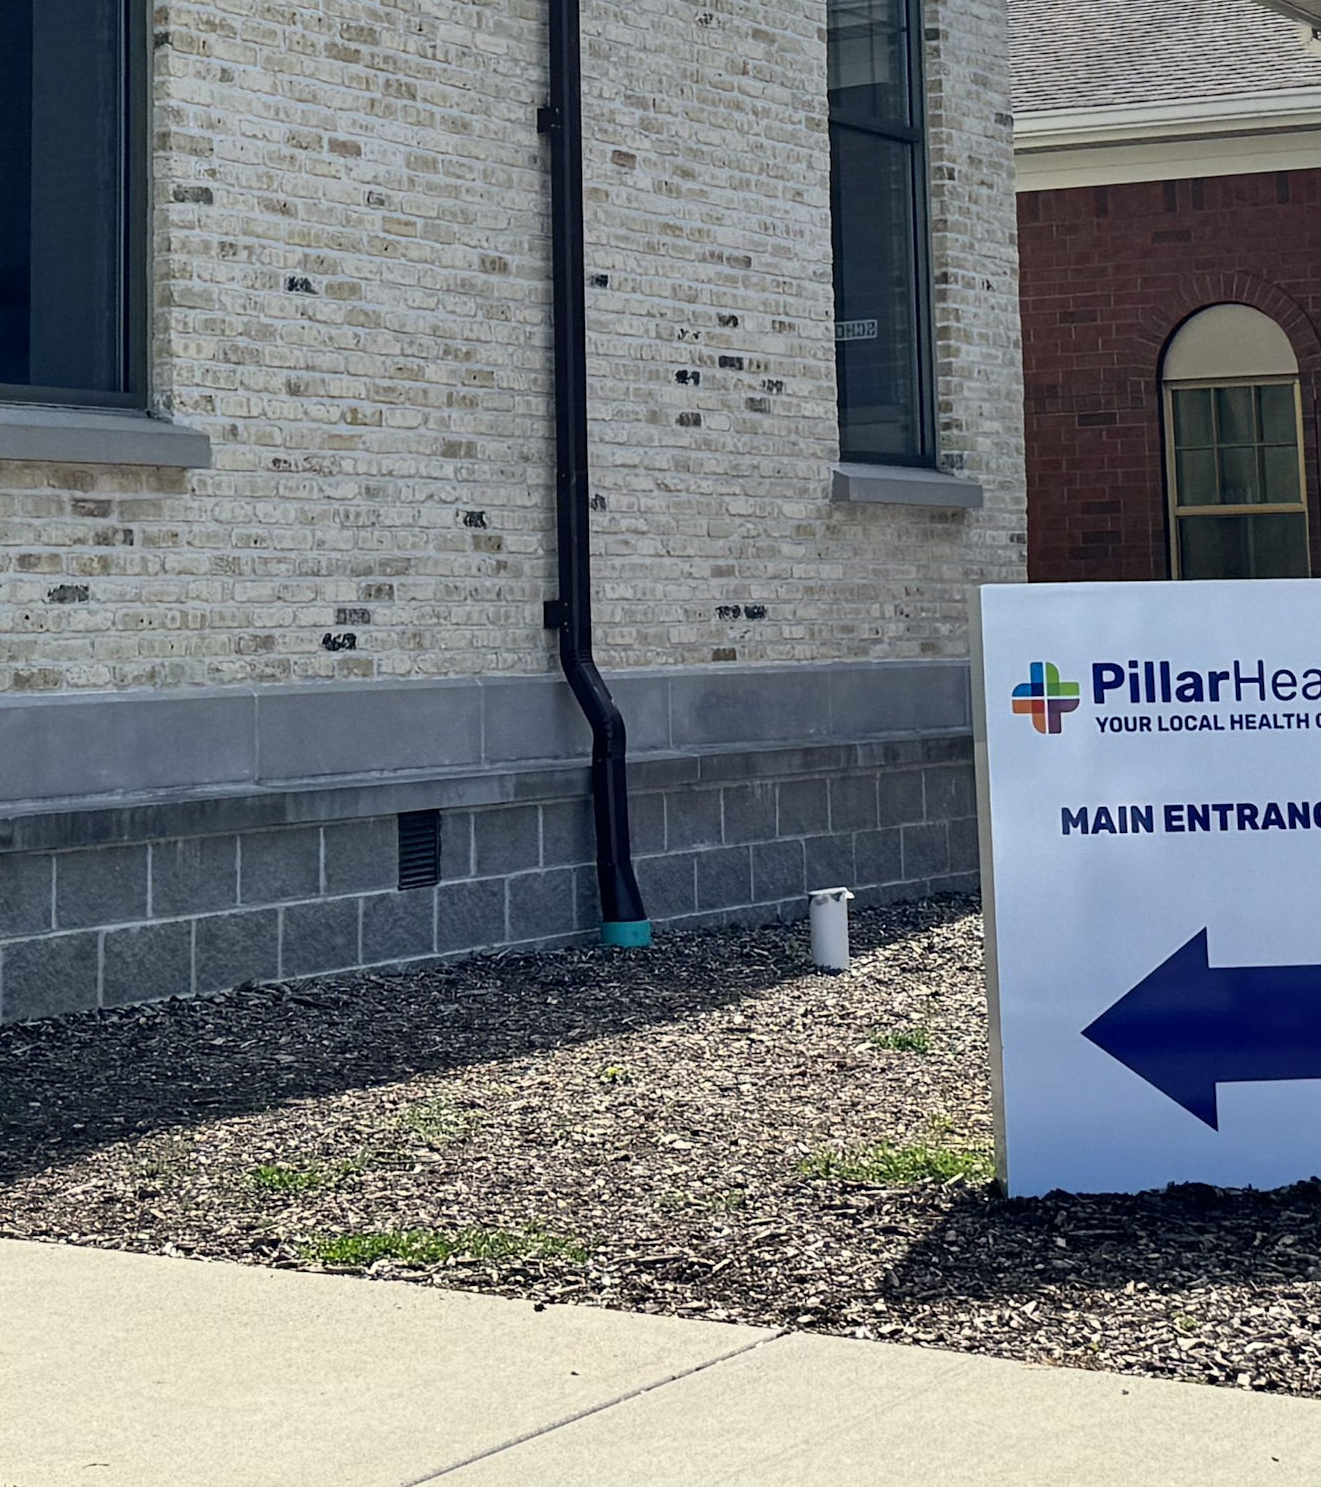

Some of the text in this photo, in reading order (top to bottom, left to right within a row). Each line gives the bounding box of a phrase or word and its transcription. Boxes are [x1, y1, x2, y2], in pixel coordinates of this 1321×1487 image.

[1095, 715, 1152, 733] YOUR
[1157, 714, 1225, 732] LOCAL
[1230, 713, 1310, 730] HEALTH
[1060, 805, 1154, 836] MAIN
